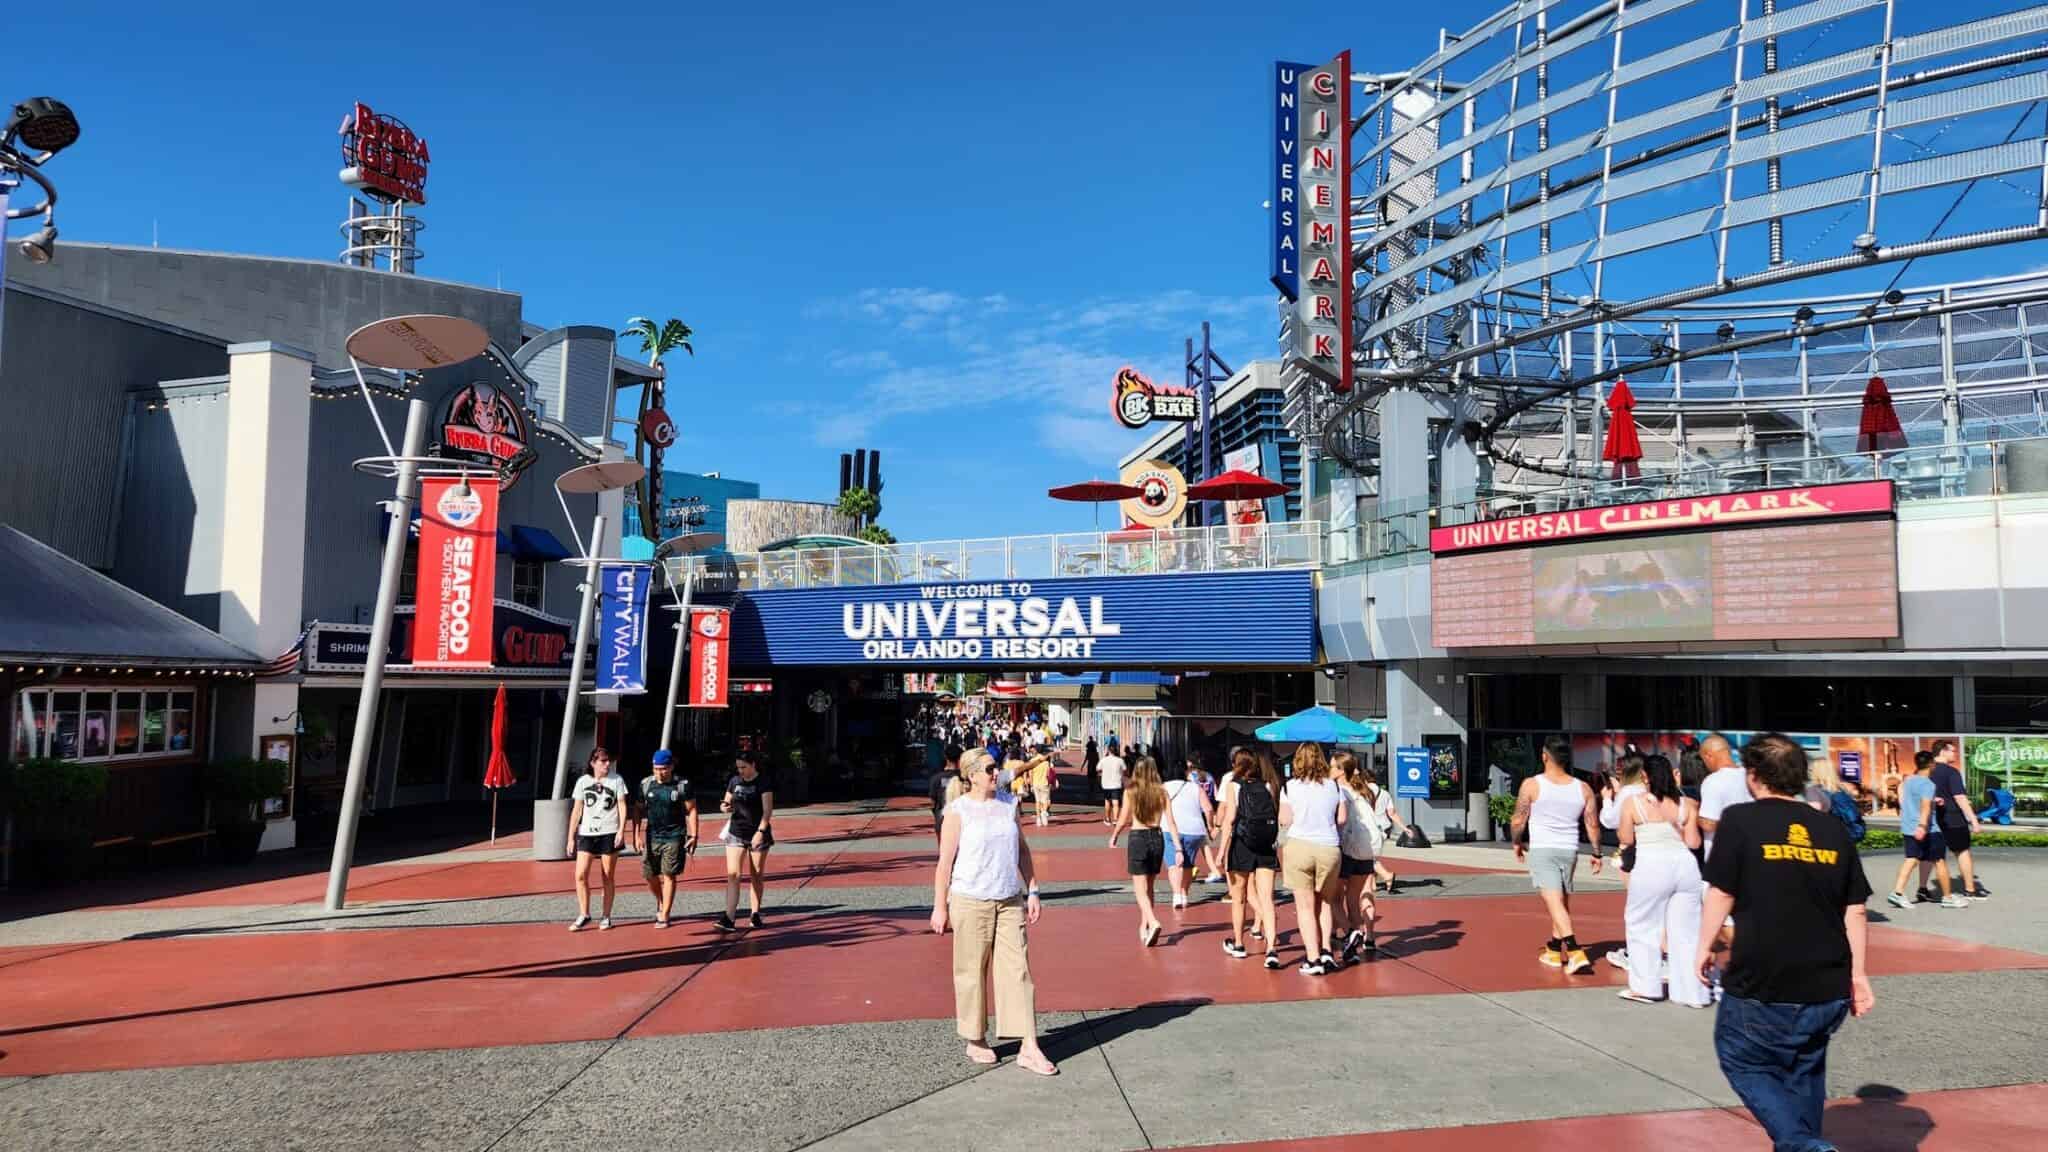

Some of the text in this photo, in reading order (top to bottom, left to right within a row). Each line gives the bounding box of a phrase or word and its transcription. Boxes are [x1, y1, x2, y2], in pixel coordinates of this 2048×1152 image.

[1281, 69, 1294, 274] UNIVERSAL
[1312, 72, 1334, 357] CINEMARK
[1154, 402, 1195, 417] BAR
[446, 428, 489, 452] BUBBA
[1453, 490, 1832, 547] UNIVERSAL CINEMARK
[440, 544, 454, 601] SOUTHERN
[449, 536, 473, 654] SEAFOOD
[920, 583, 1031, 599] WELCOME TO
[437, 604, 451, 661] FAVORITES
[503, 626, 566, 664] GUMP
[612, 571, 635, 689] CITYWALK
[843, 596, 1121, 640] UNIVERSAL
[706, 641, 718, 701] SEAFOOD
[863, 637, 1096, 660] ORLANDO RESORT
[1761, 844, 1838, 865] BREW
